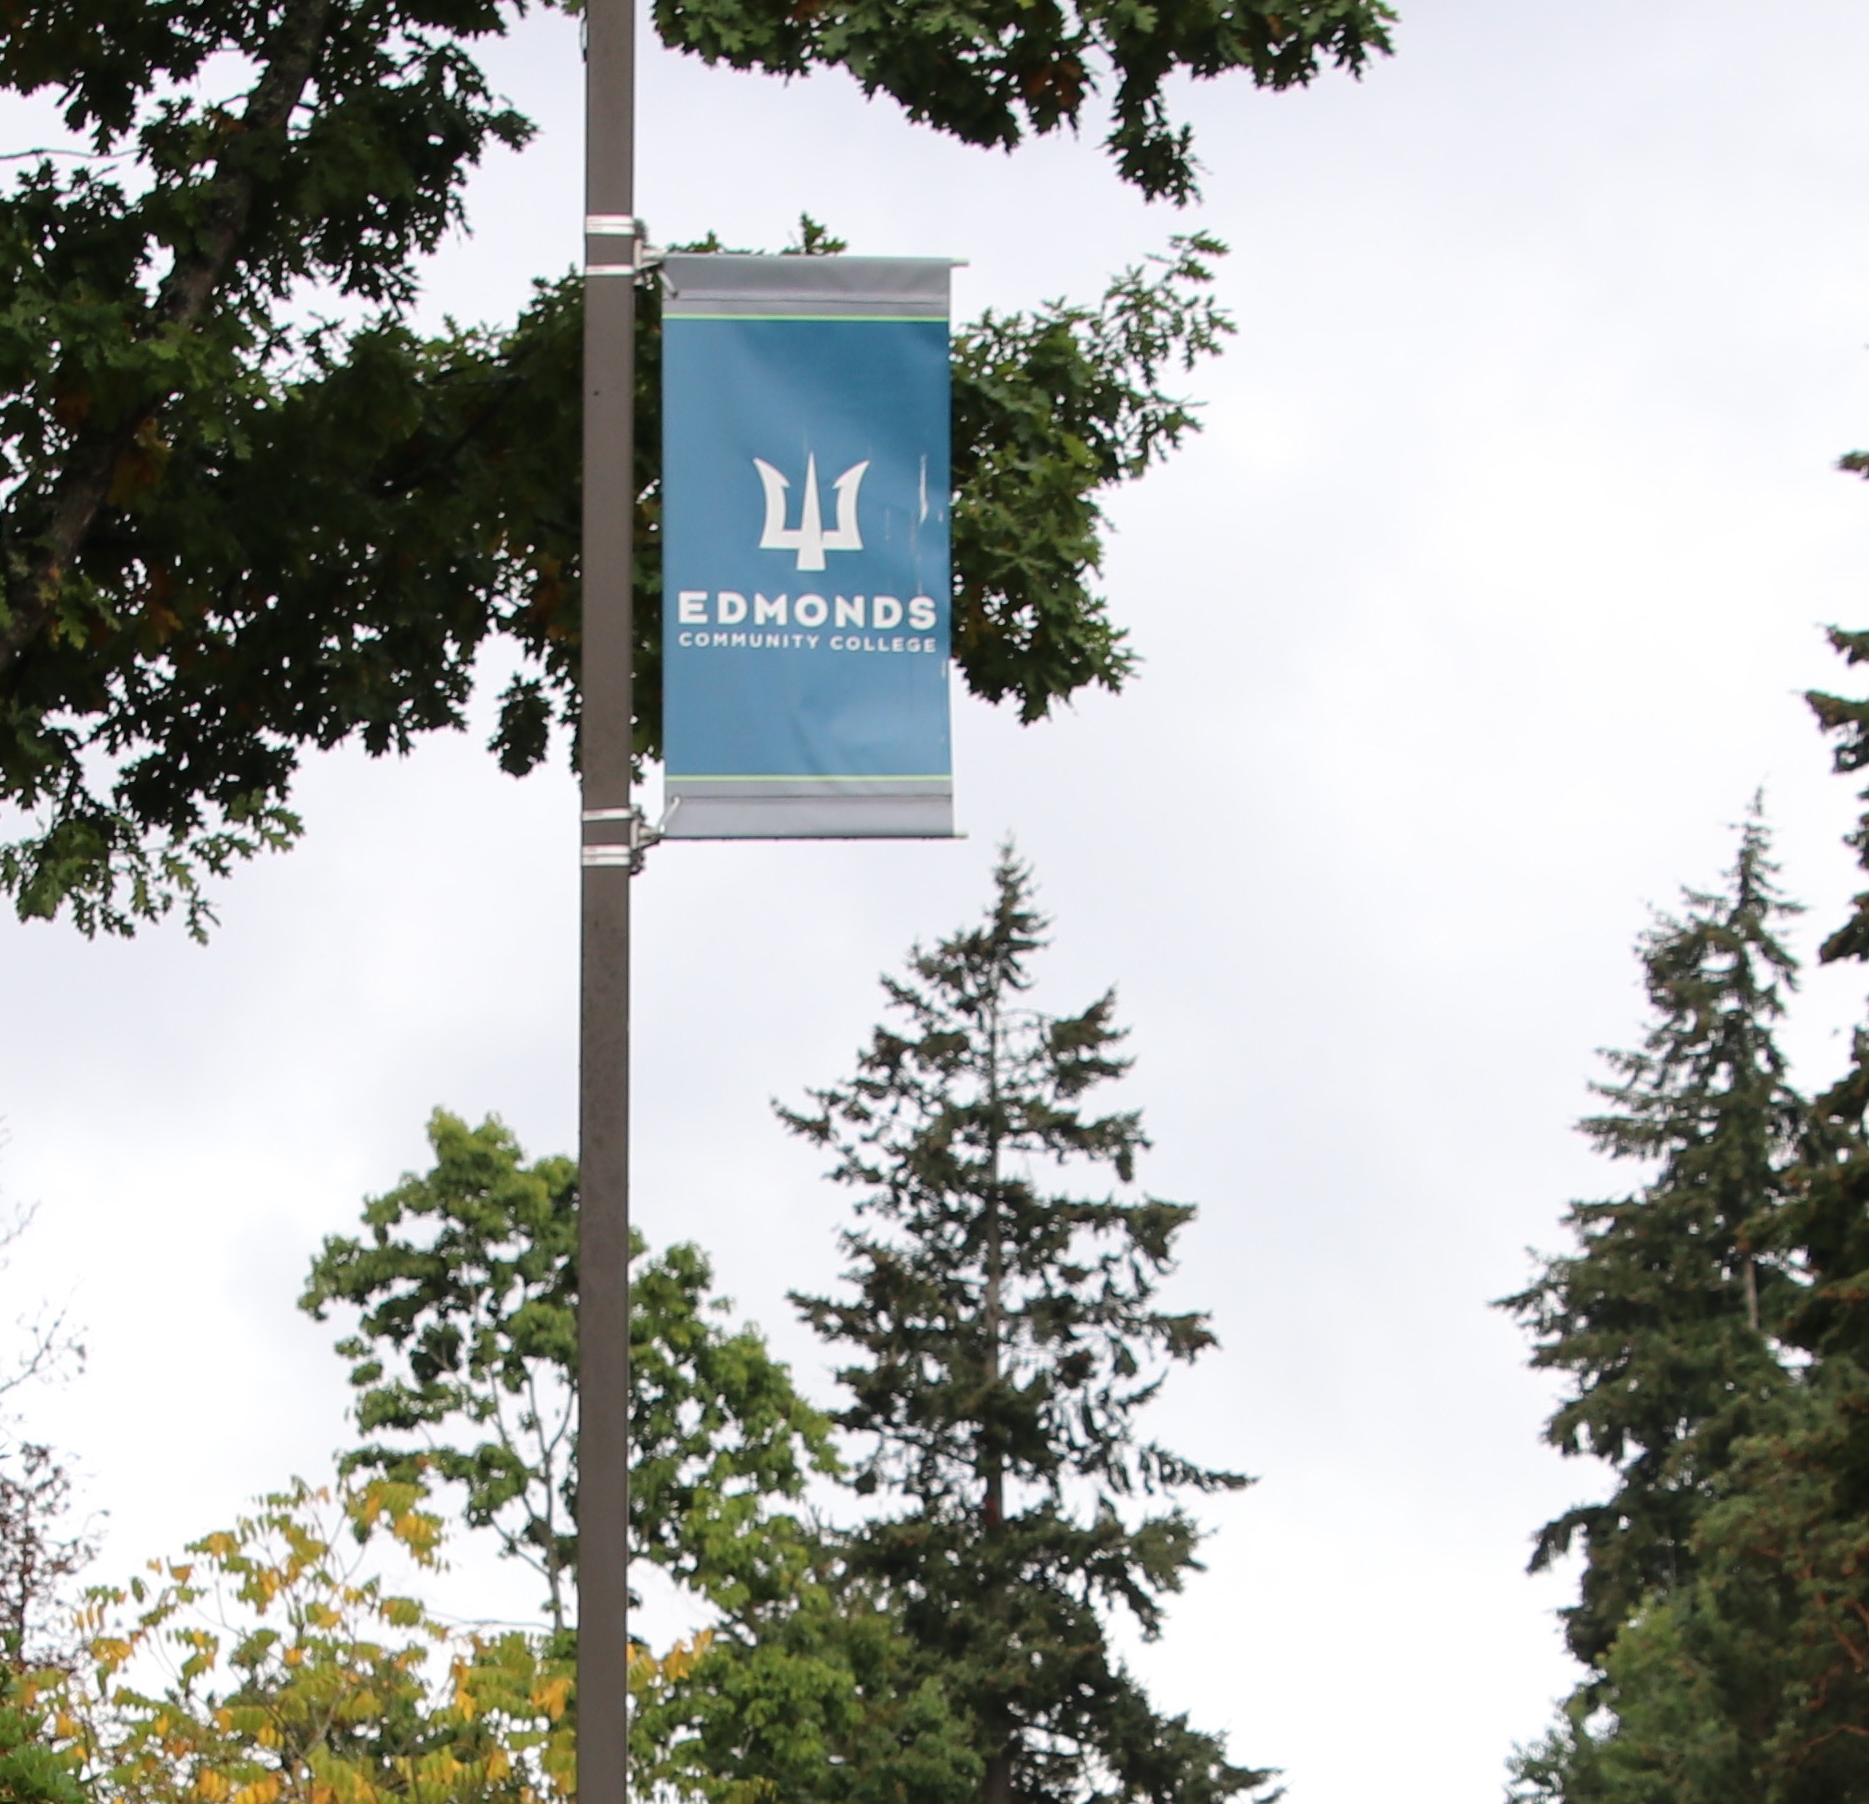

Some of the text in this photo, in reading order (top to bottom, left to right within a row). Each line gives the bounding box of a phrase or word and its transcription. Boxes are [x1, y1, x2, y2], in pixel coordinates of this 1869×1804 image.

[679, 591, 936, 630] EDMONDS
[679, 633, 935, 652] COMMUNITY COLLEGE
